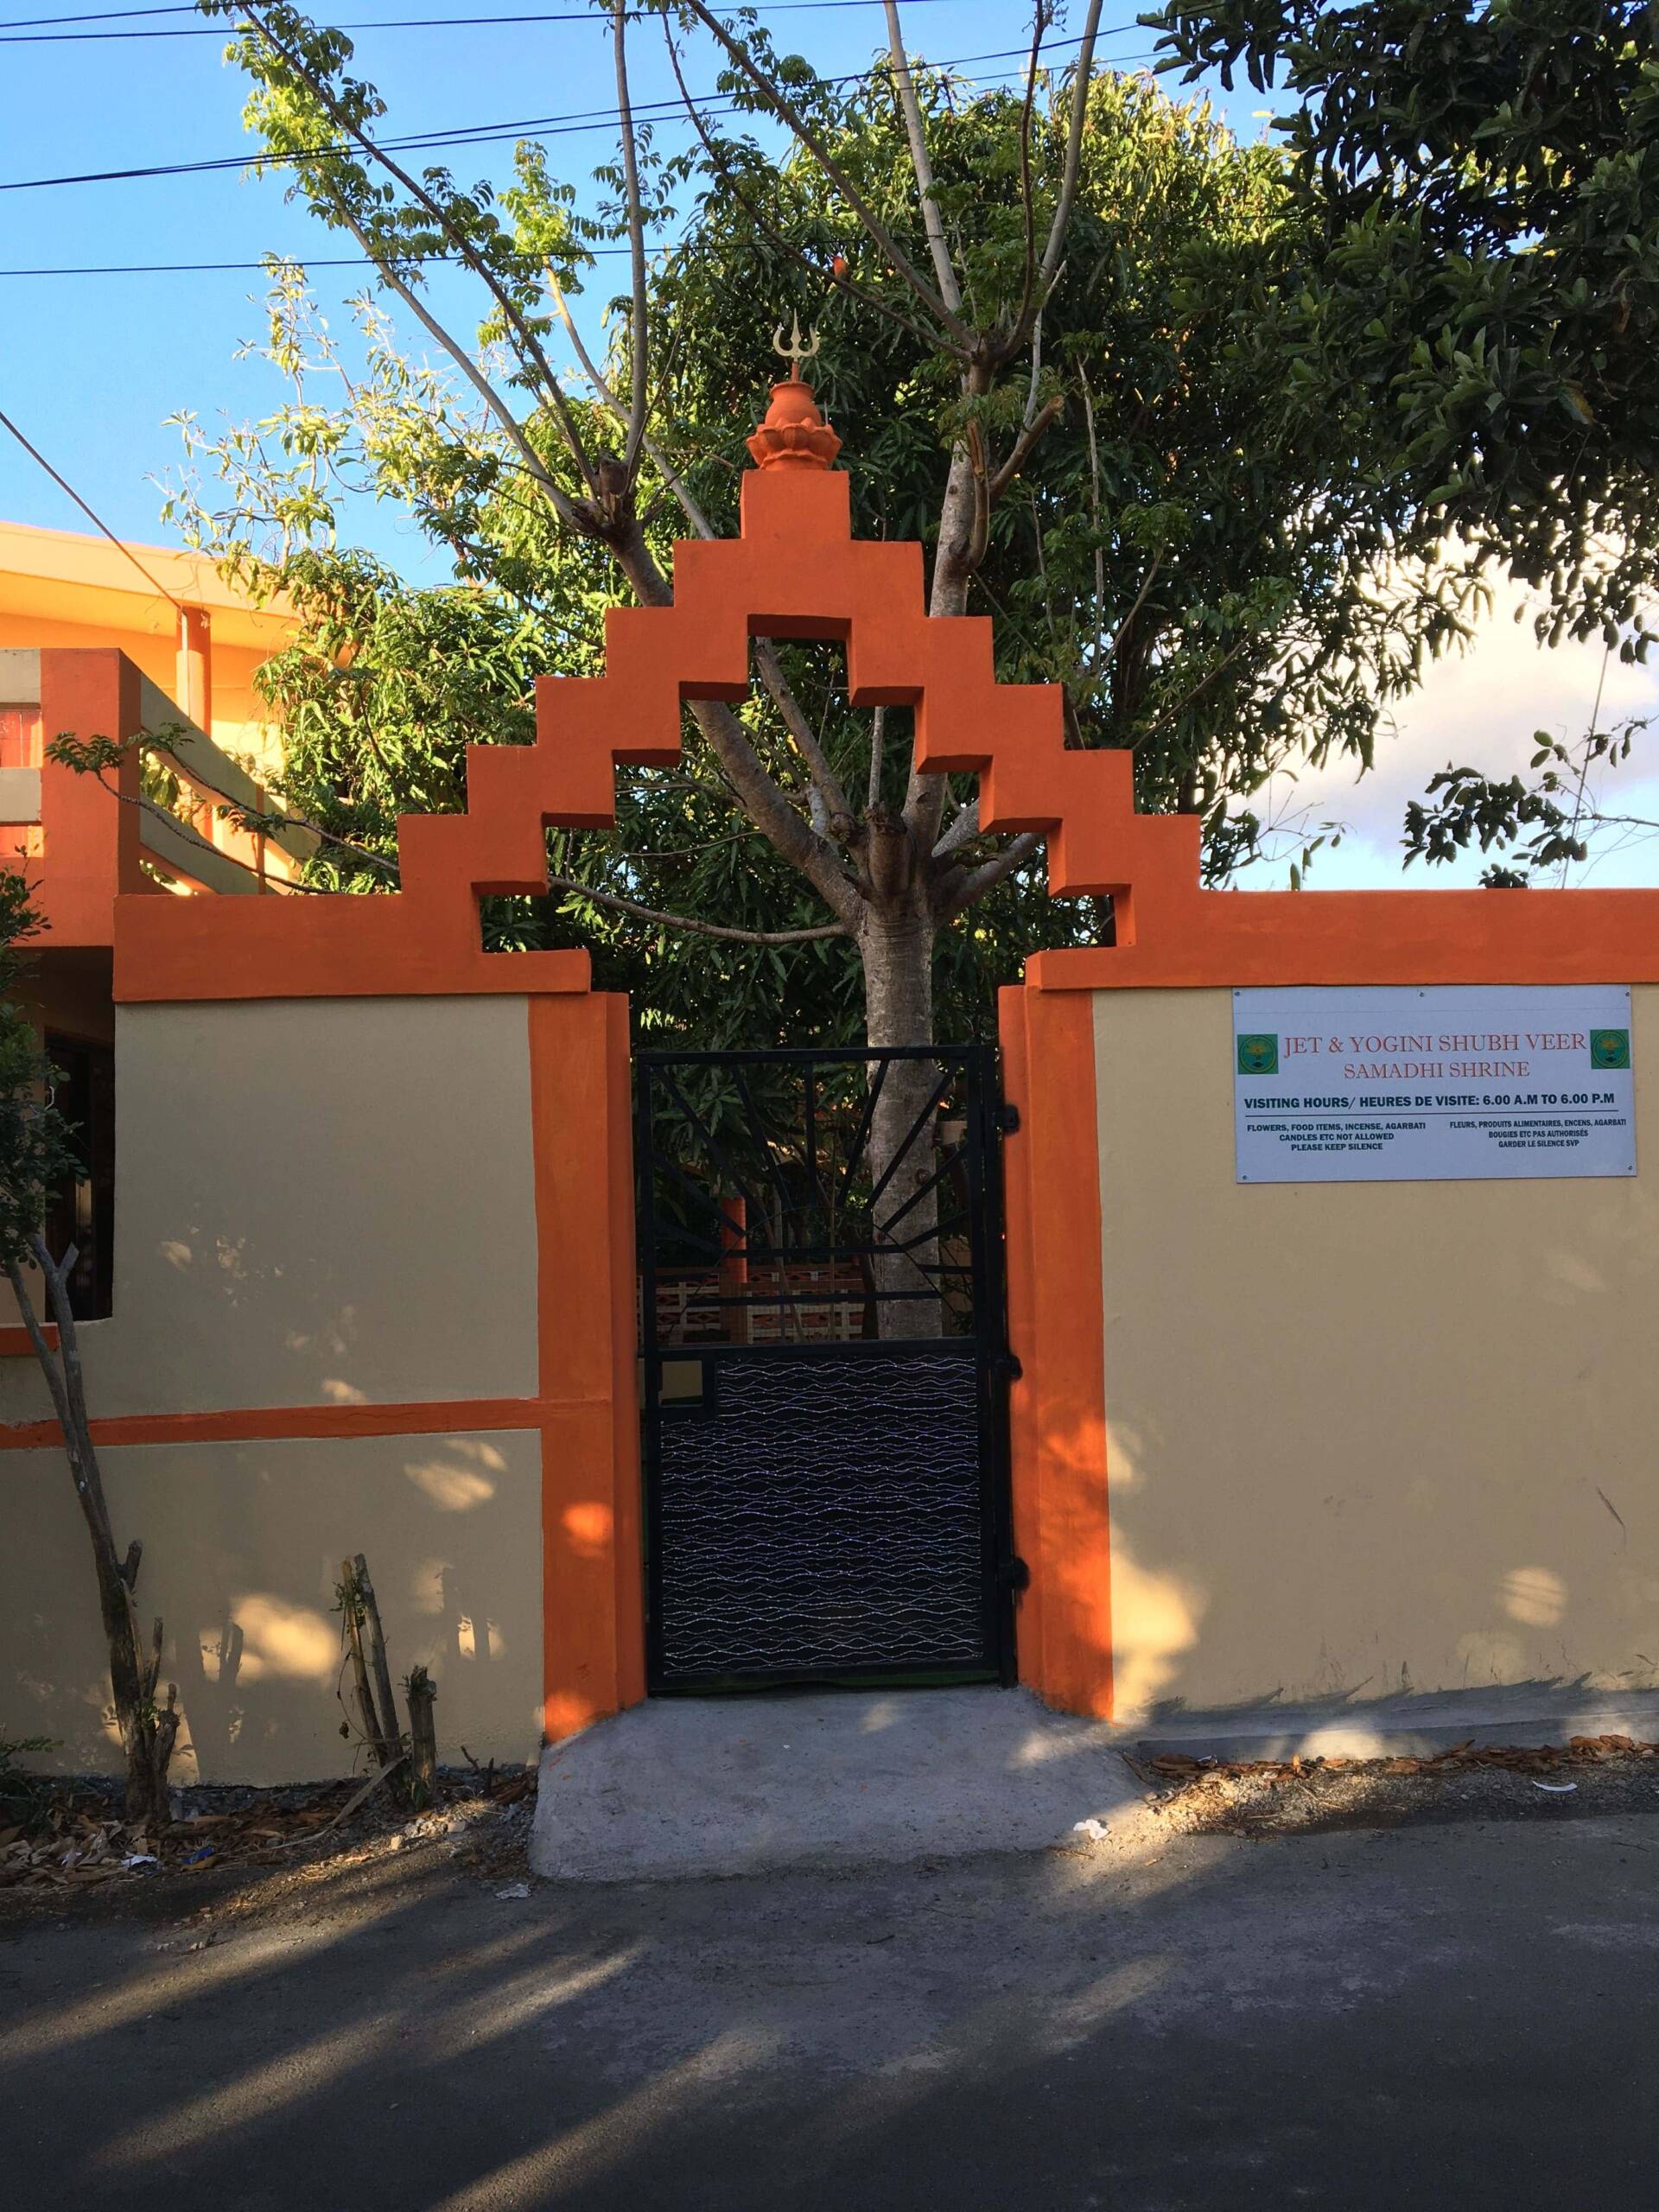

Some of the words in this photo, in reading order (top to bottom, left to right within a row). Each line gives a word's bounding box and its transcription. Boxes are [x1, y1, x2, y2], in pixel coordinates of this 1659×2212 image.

[1284, 1037, 1322, 1058] JET
[1328, 1037, 1344, 1053] &
[1351, 1036, 1433, 1053] YOGINI
[1439, 1034, 1520, 1052] SHUBH
[1524, 1033, 1587, 1051] VEER
[1344, 1063, 1443, 1079] SAMADHI
[1449, 1061, 1530, 1077] SHRINE
[1244, 1098, 1300, 1109] VISITING
[1303, 1097, 1356, 1109] HOURS/
[1359, 1096, 1411, 1108] HEURES
[1415, 1096, 1433, 1106] DE
[1435, 1096, 1480, 1106] VISITE:
[1483, 1095, 1510, 1105] 6.00
[1514, 1094, 1538, 1105] A.M
[1541, 1094, 1557, 1104] TO
[1560, 1093, 1588, 1104] 6.00
[1592, 1093, 1615, 1103] P.M
[1344, 1122, 1383, 1131] INCENSE,
[1385, 1122, 1426, 1130] AGARBATI
[1450, 1121, 1478, 1129] FLEURS,
[1513, 1120, 1563, 1128] ALIMENTAIRES,
[1564, 1119, 1593, 1128] ENCENS,
[1594, 1118, 1627, 1127] AGARBATI
[1547, 1128, 1588, 1137] AUTHORISÉS
